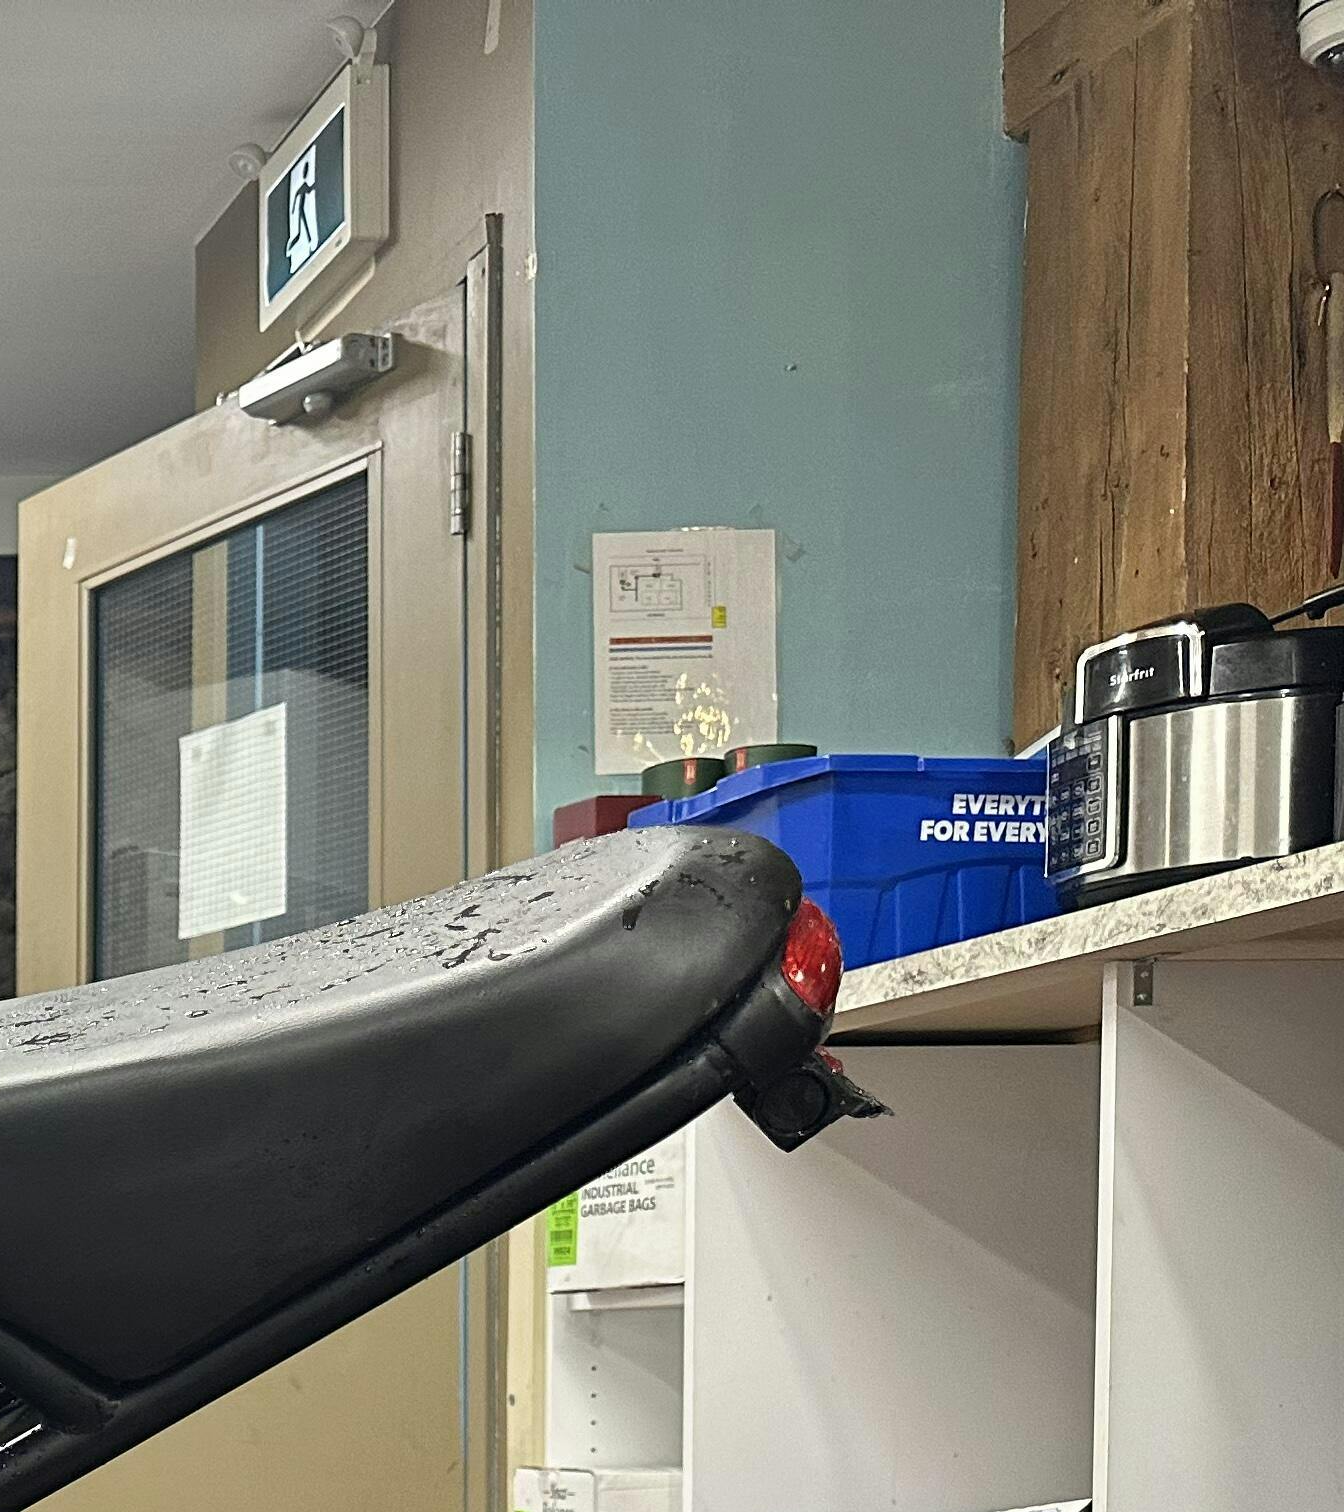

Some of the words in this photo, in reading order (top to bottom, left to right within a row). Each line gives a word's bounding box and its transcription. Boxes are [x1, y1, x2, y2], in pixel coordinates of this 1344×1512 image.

[920, 820, 970, 842] FOR
[581, 1181, 640, 1201] INDUSTRIAL
[580, 1199, 626, 1218] GARBAGE
[627, 1196, 657, 1213] BAGS
